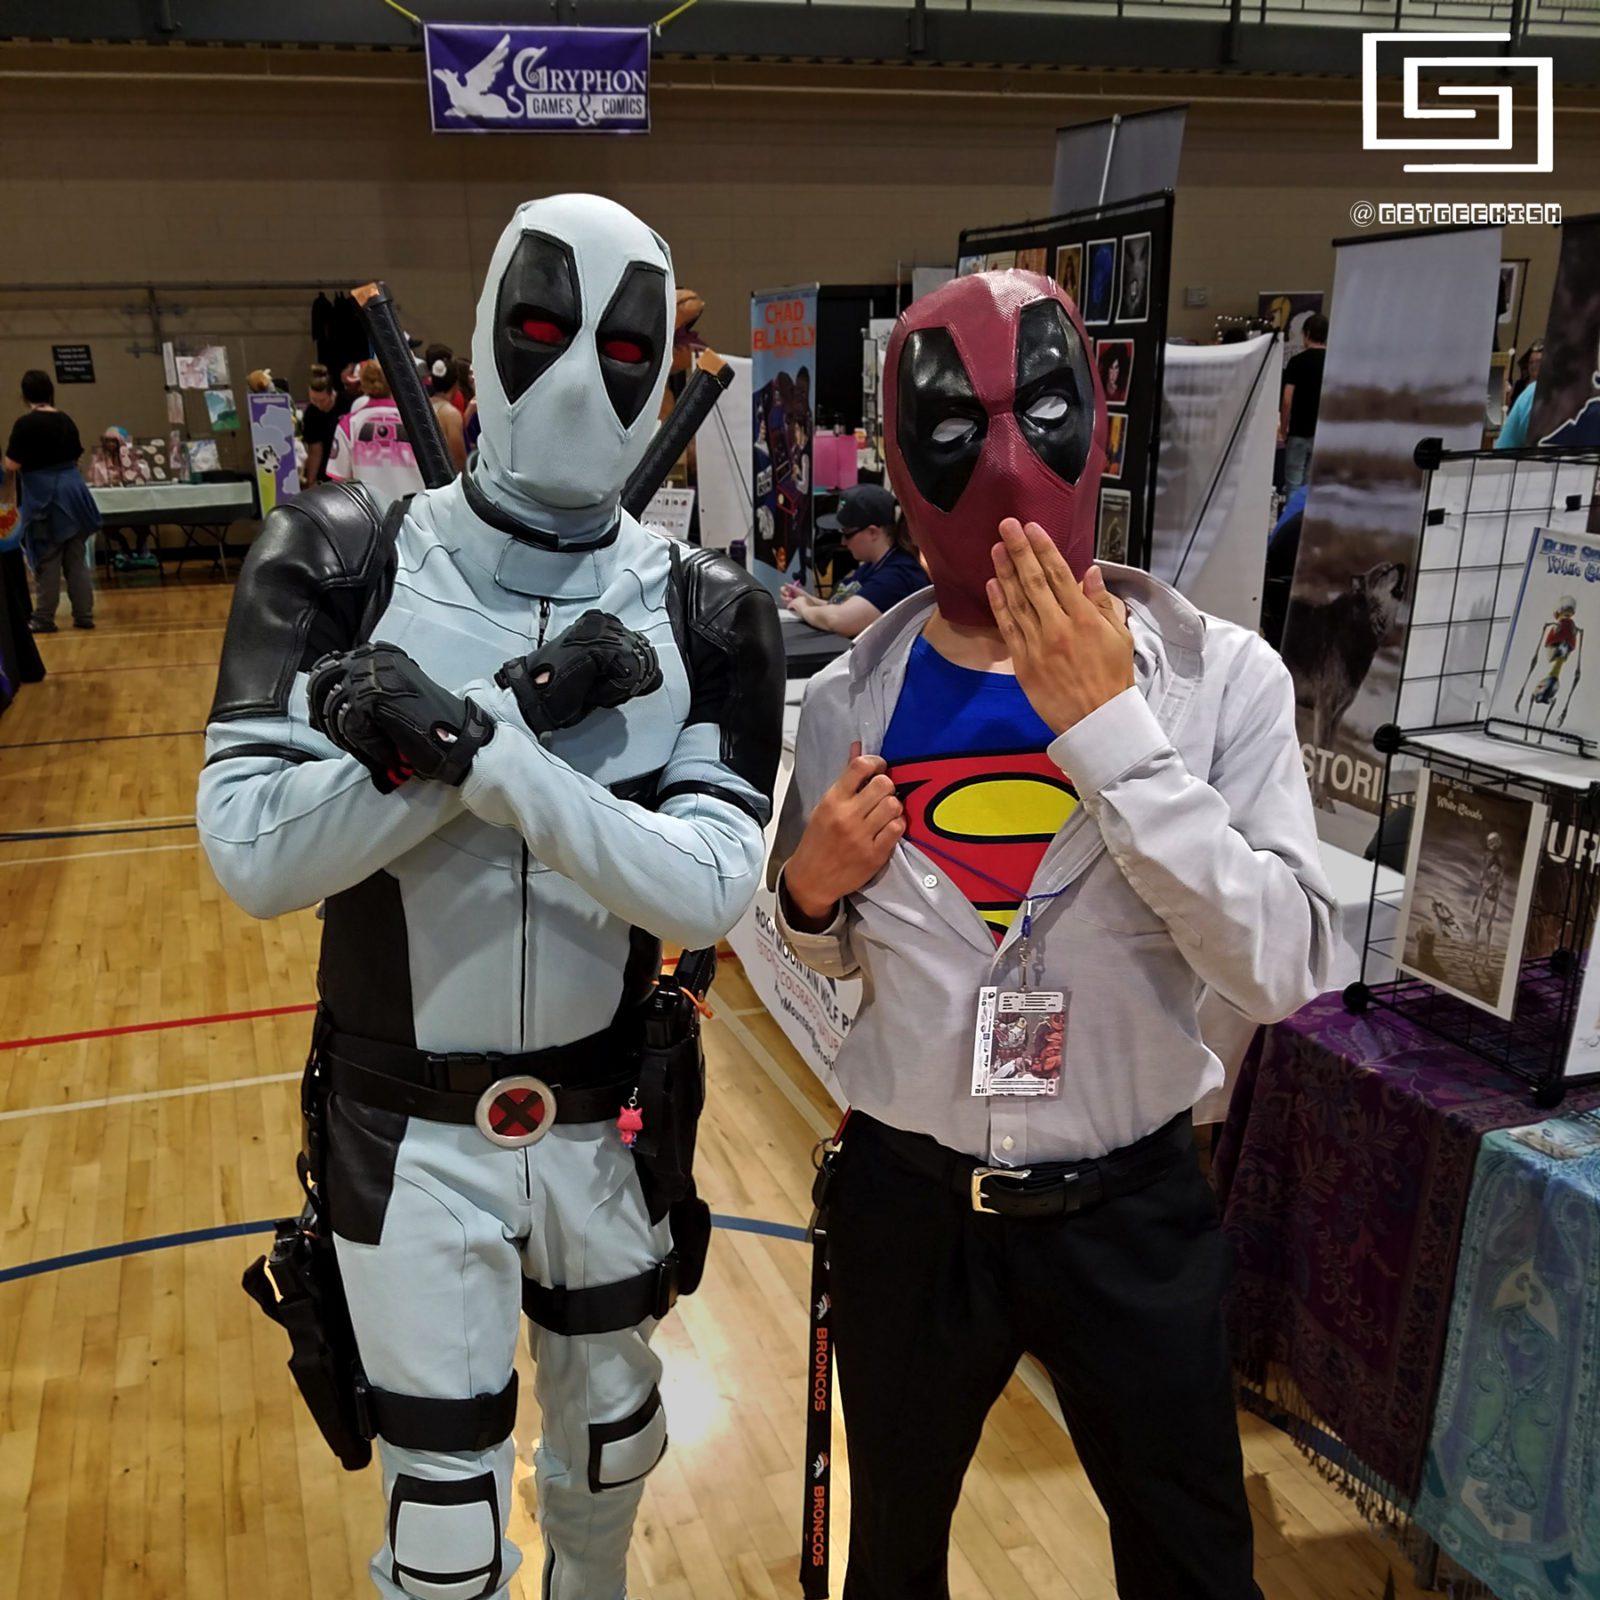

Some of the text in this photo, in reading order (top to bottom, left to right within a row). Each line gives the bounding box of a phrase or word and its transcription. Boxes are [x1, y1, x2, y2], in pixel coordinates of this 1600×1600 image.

[512, 46, 647, 93] GRYPHON
[532, 91, 643, 126] GAMES & COMICS
[764, 299, 805, 325] CHAD
[752, 325, 816, 352] BLAKELY
[814, 1326, 829, 1413] BRONCOS
[812, 1485, 826, 1568] BRONCOS
